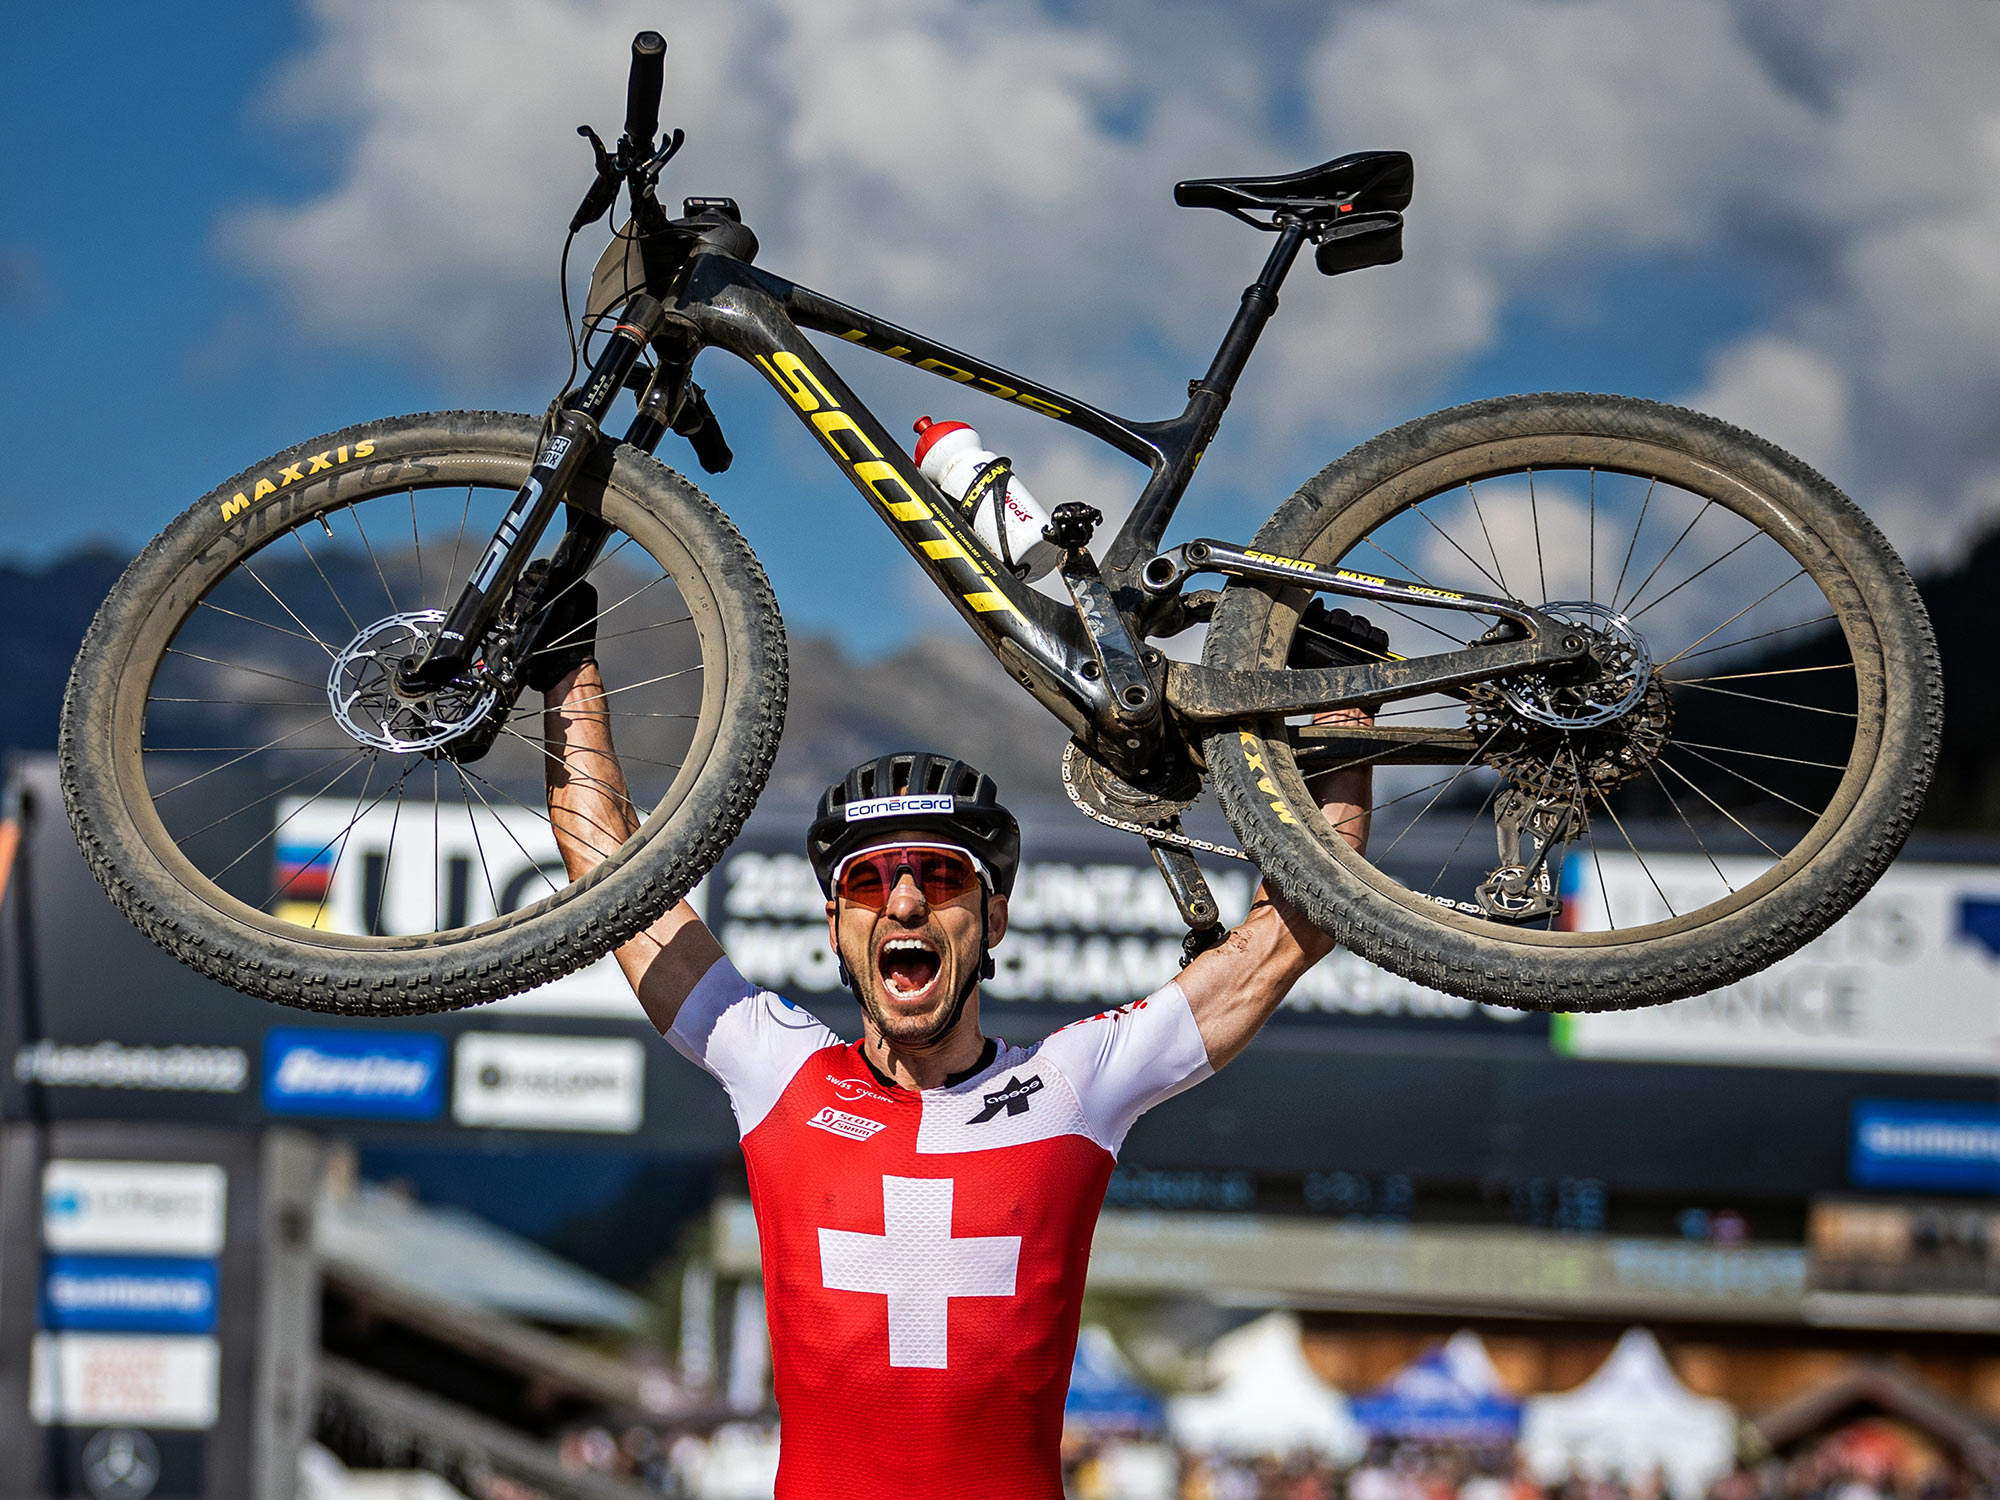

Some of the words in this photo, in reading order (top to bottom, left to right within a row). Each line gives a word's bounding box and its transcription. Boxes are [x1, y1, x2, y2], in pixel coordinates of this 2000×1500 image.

[824, 329, 1073, 418] SCOTT
[220, 438, 375, 523] MAXXIS
[755, 351, 1032, 627] SCOTT
[961, 464, 1009, 508] TOPEAK
[930, 502, 956, 529] INNOVATION
[954, 530, 982, 559] TECHNOLOGY
[1242, 549, 1316, 573] SRAM
[1335, 569, 1386, 587] MAXXIS
[825, 1074, 852, 1090] SWISS
[855, 1088, 894, 1104] CYCLING
[986, 1080, 1040, 1104] assos
[836, 1122, 870, 1137] SRAM
[838, 1113, 881, 1130] SCOTT
